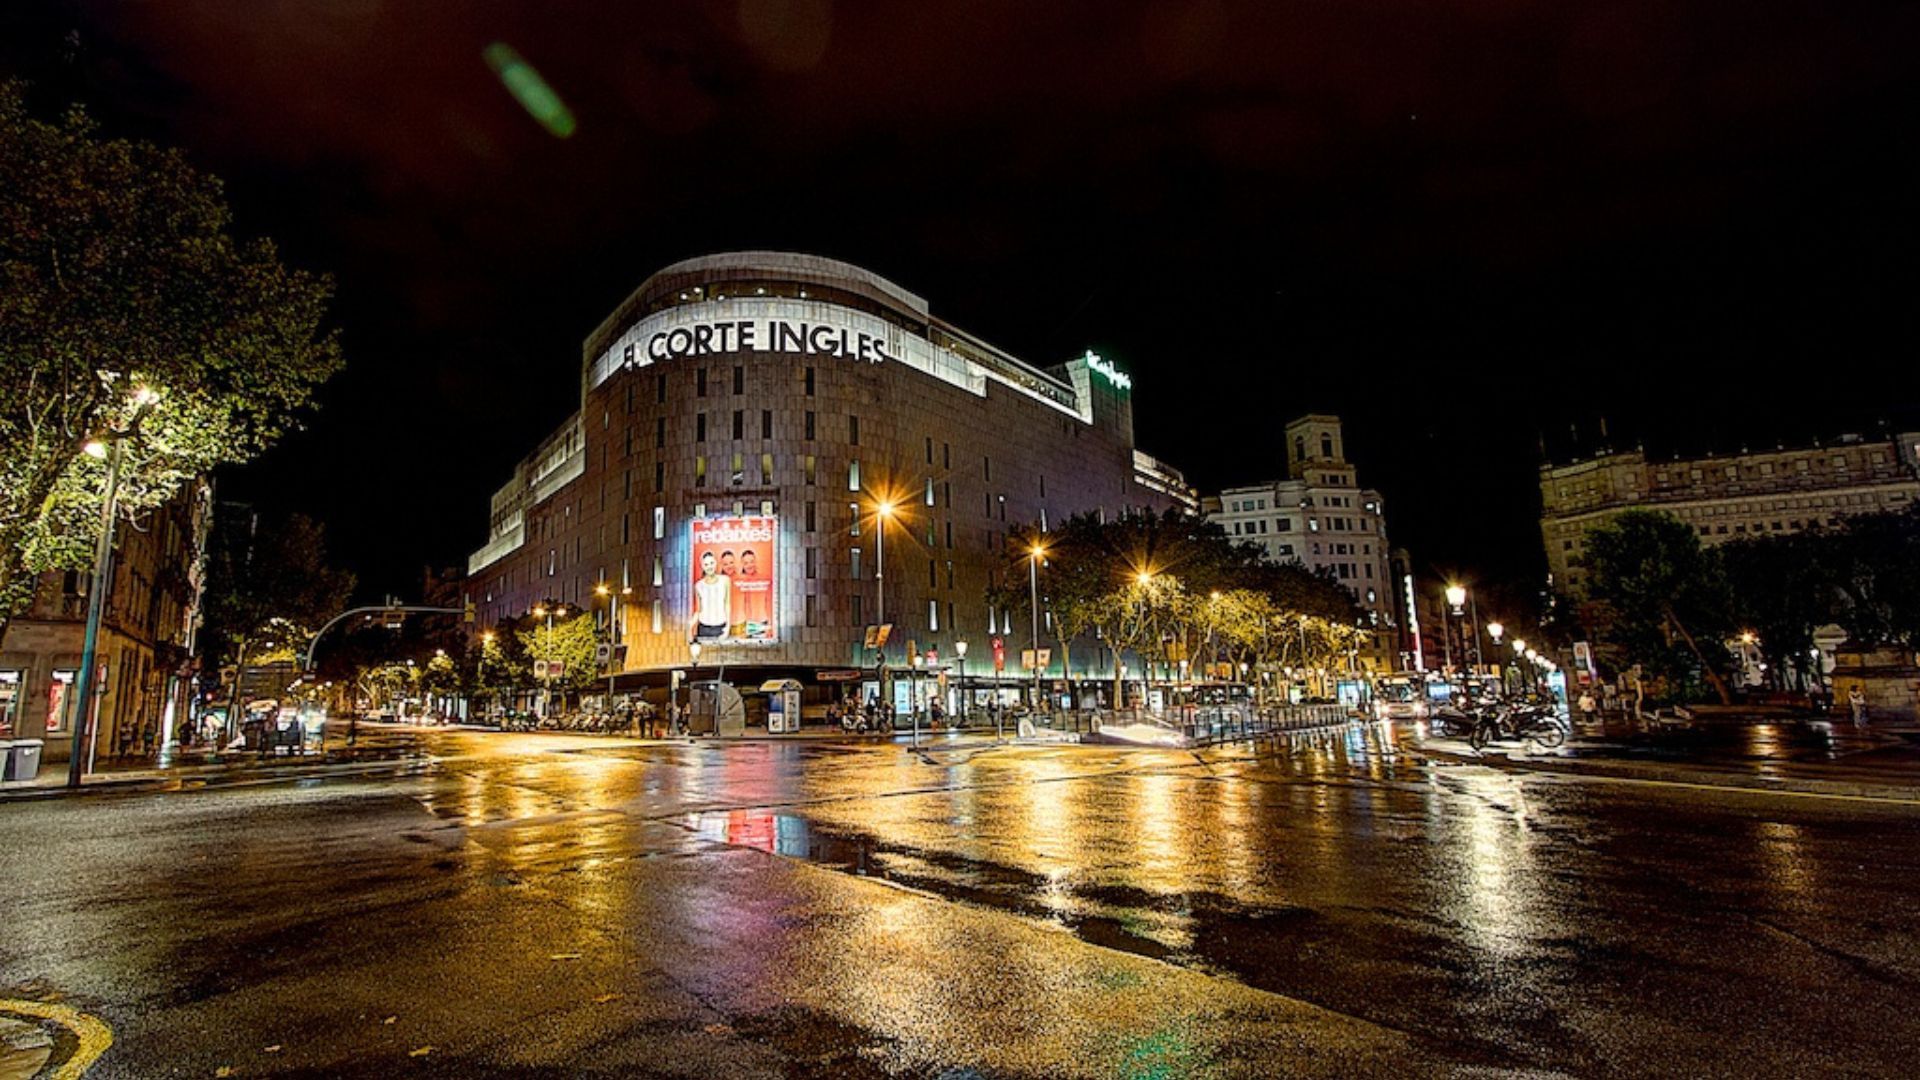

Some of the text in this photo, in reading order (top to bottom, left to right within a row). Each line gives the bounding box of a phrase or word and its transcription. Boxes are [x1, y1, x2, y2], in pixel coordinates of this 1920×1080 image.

[624, 321, 886, 371] EL CORTE INGLES
